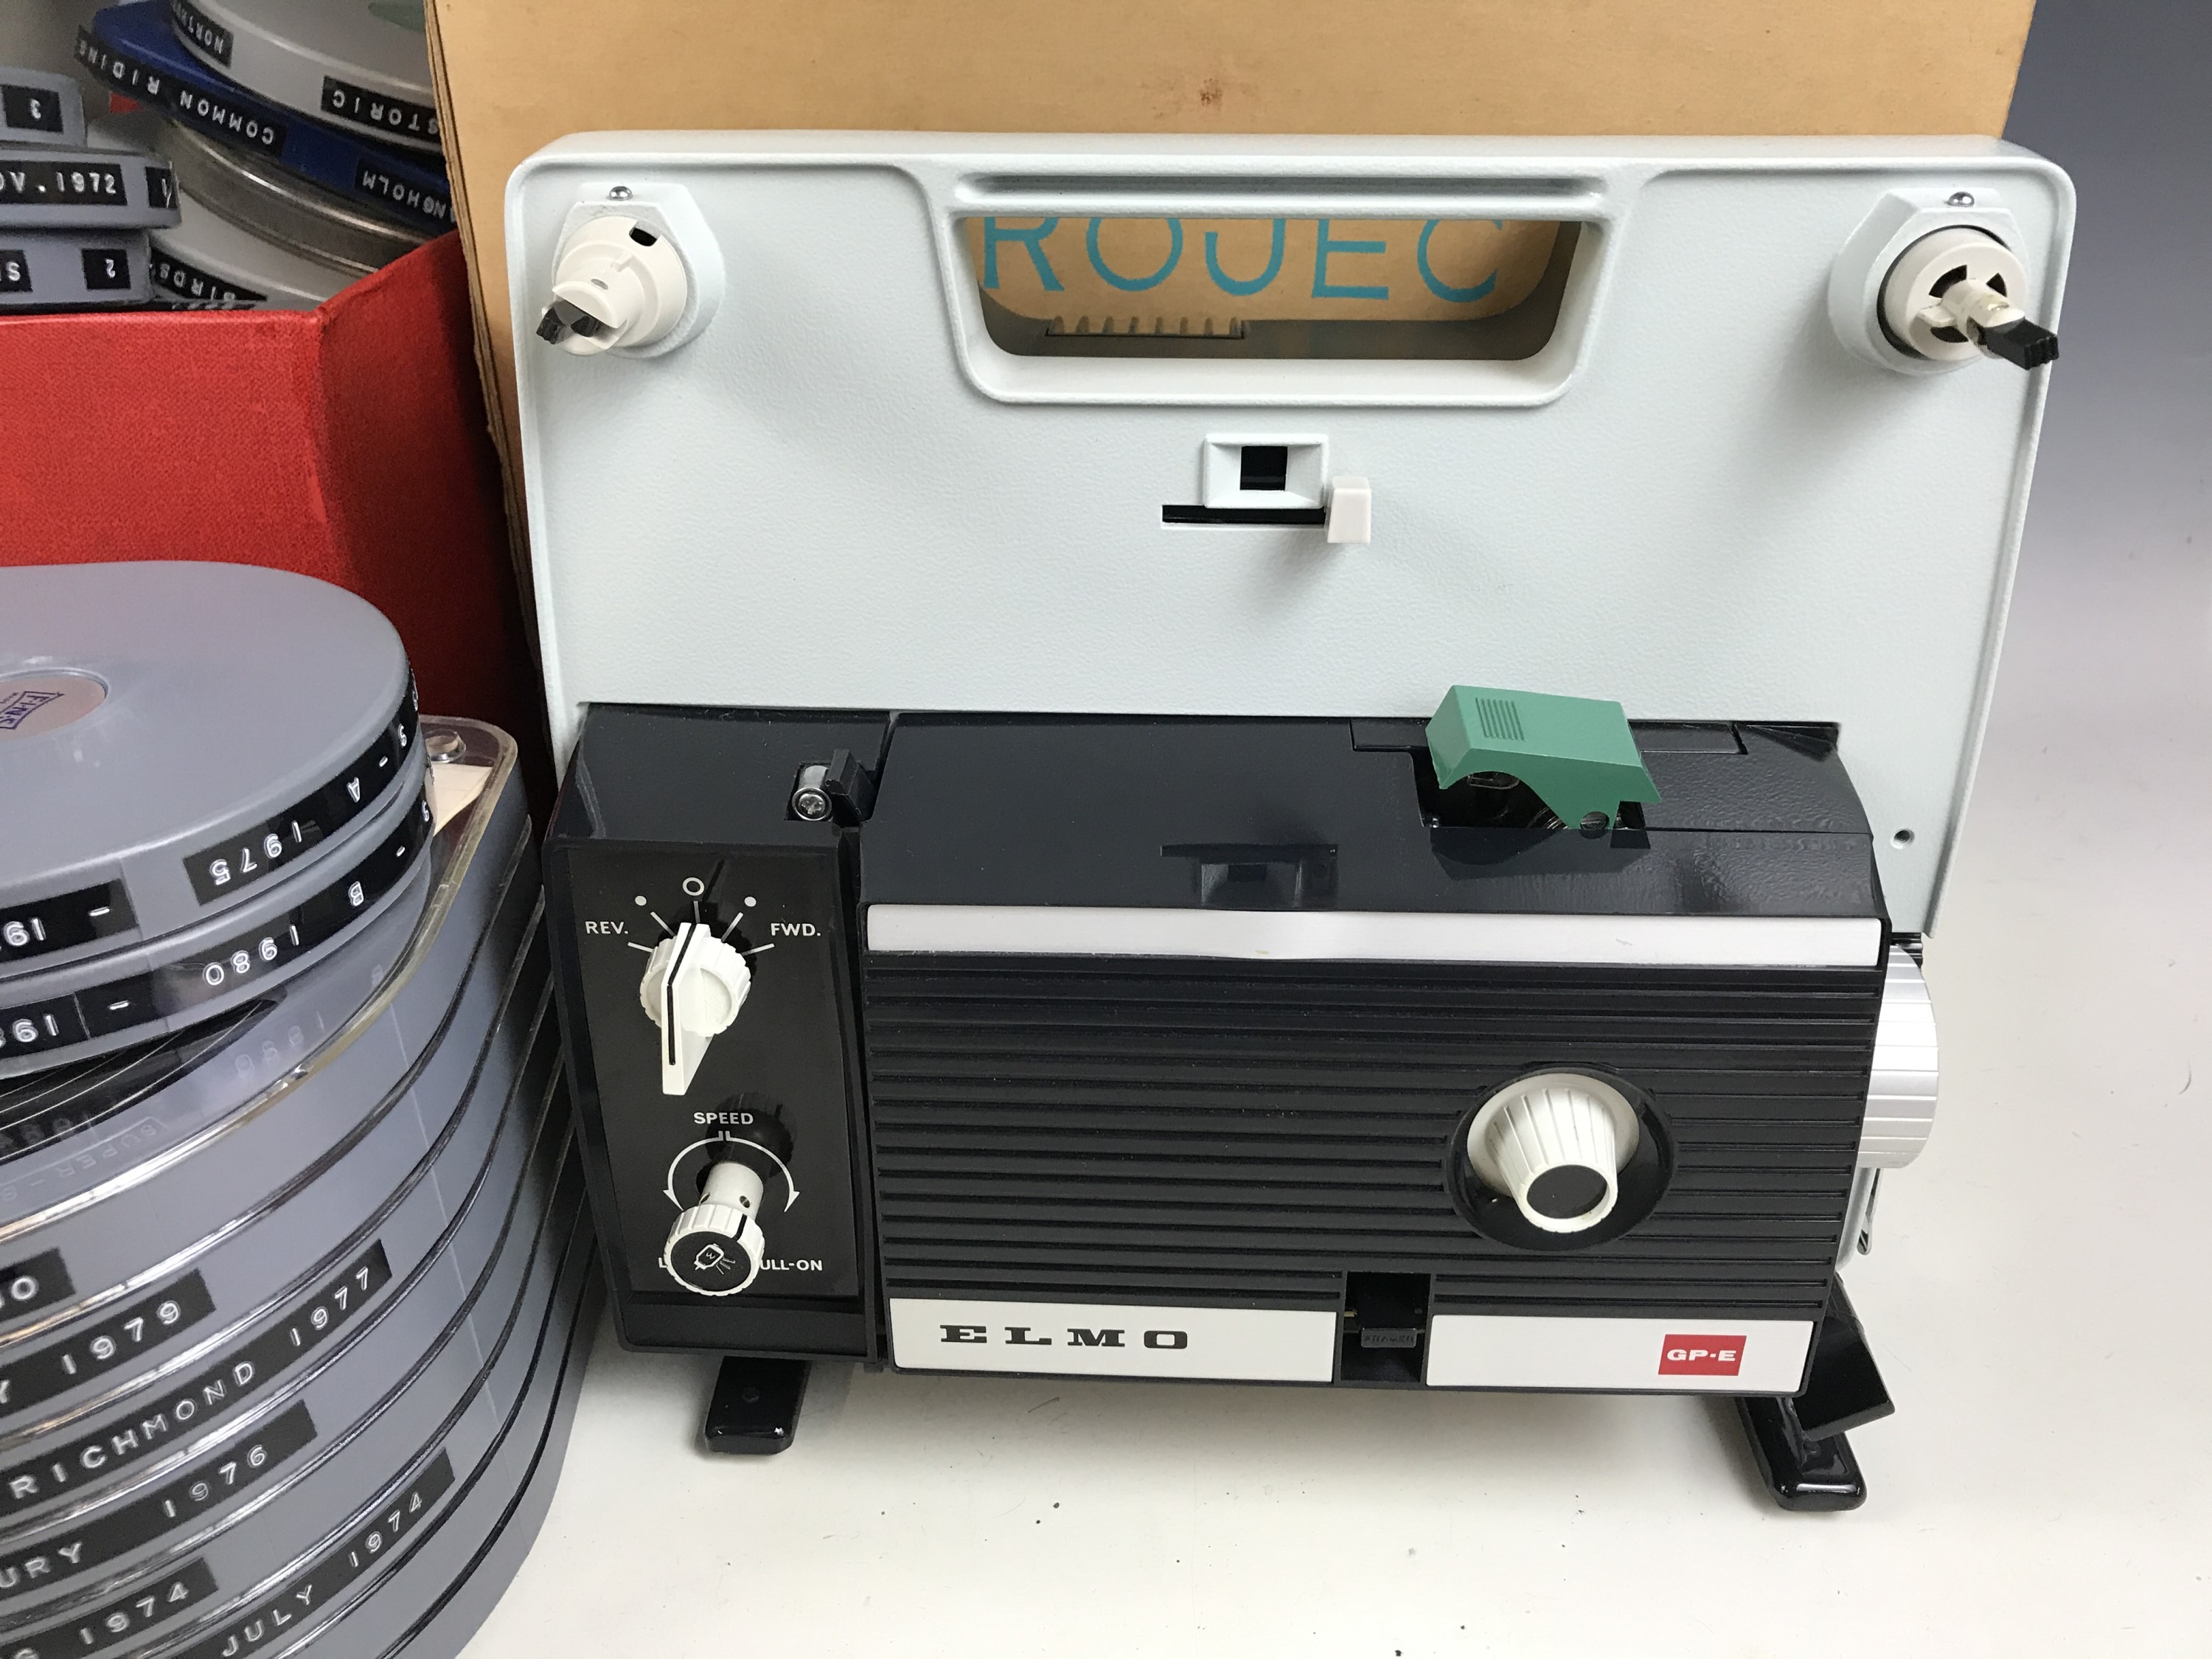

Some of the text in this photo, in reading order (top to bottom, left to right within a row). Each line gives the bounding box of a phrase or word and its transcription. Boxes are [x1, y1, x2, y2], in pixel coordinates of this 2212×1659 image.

[30, 98, 41, 120] 3
[180, 89, 274, 145] COMMON
[105, 258, 116, 279] 2
[983, 218, 1503, 303] ROJEC
[347, 777, 361, 803] A
[209, 820, 302, 886] 1975
[348, 881, 364, 907] B
[0, 917, 46, 947] 19
[585, 922, 628, 934] REV.
[771, 923, 821, 936] FWD.
[202, 925, 299, 986] 1980
[0, 1013, 58, 1048] 19
[694, 1113, 754, 1125] SPEED
[62, 1300, 181, 1375] 1979
[940, 1325, 1188, 1349] ELMO
[9, 1266, 370, 1499] RICHMOND 1977
[162, 1444, 268, 1518] 1976
[222, 1491, 422, 1658] JULY 1974
[80, 1582, 189, 1645] 1974
